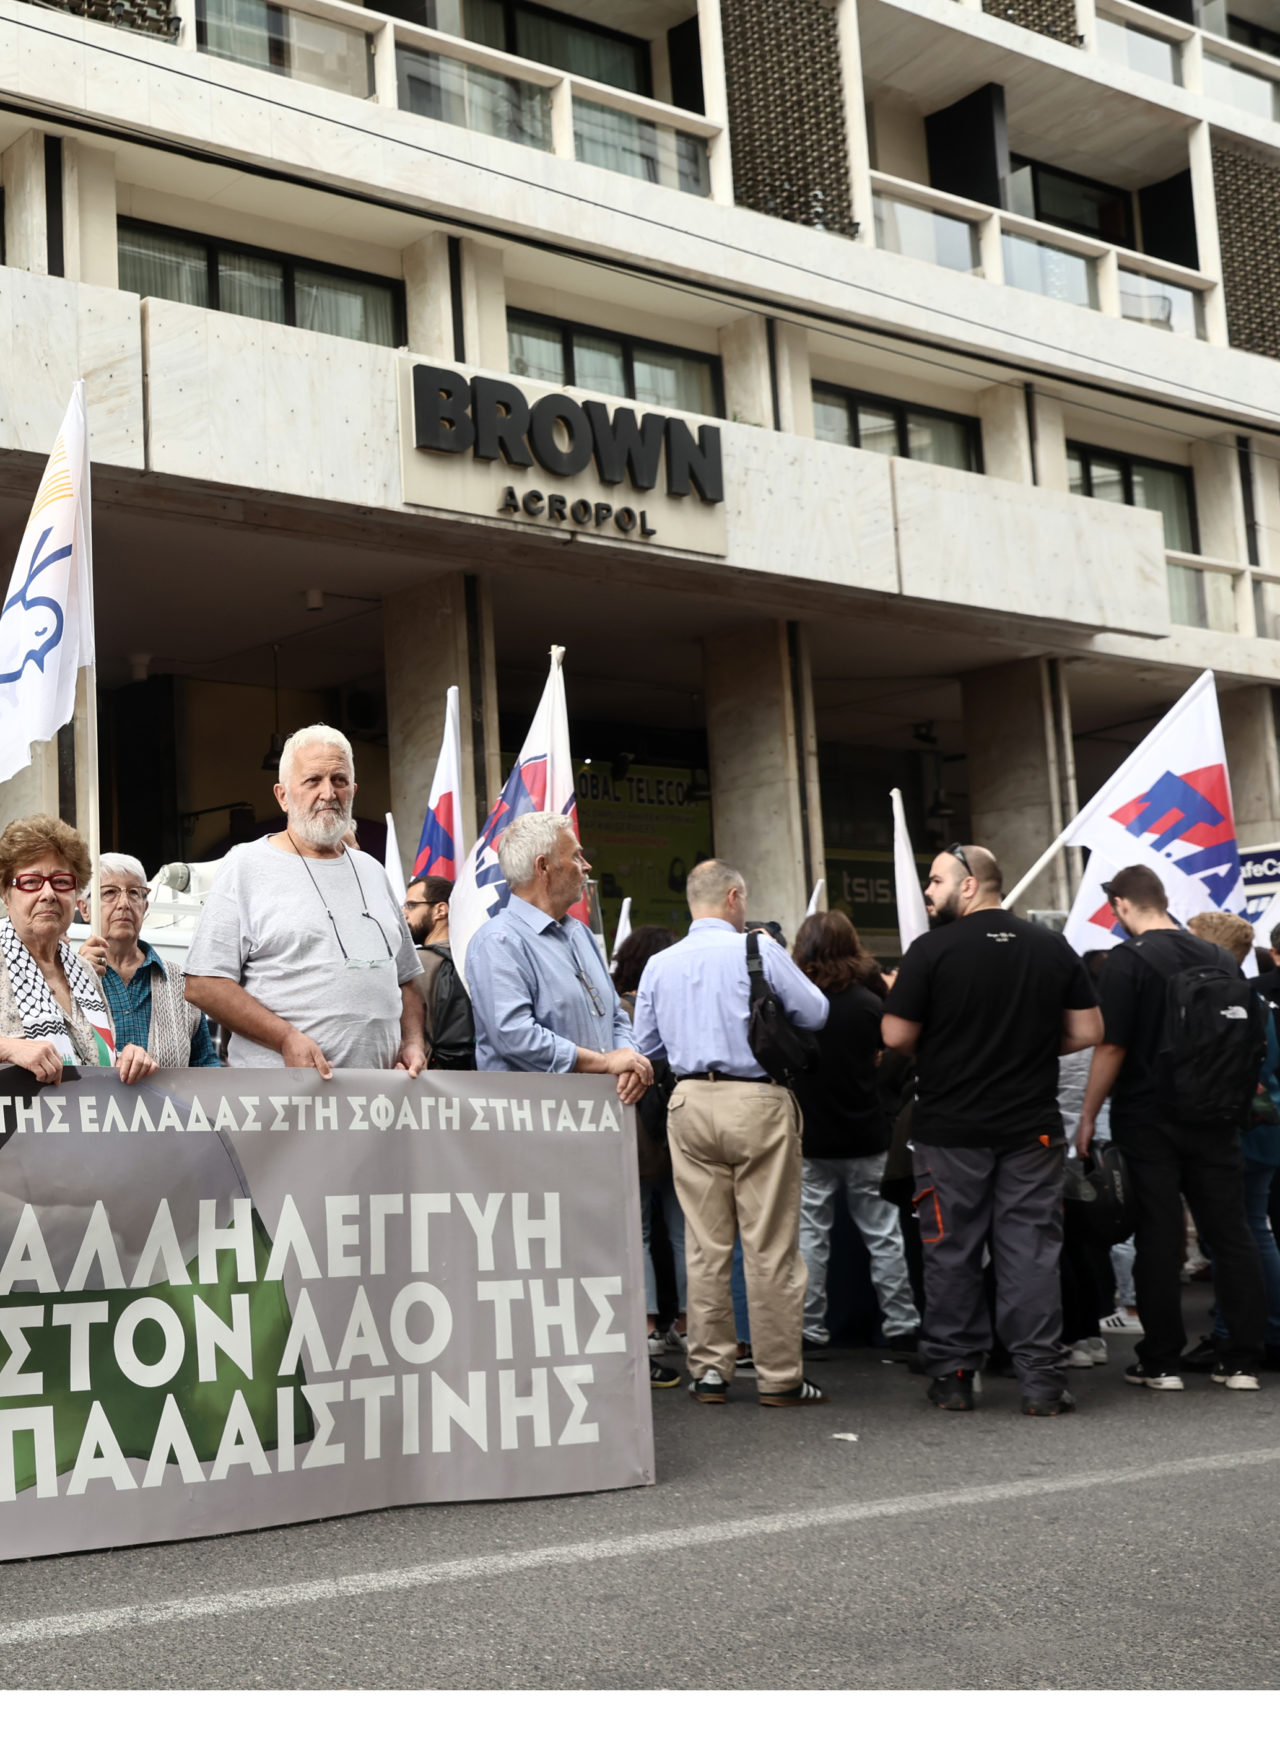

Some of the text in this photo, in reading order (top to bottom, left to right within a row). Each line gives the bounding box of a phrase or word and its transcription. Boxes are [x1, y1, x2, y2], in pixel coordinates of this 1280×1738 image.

[412, 363, 724, 505] BROWN
[497, 485, 656, 537] ACROPOL
[79, 1094, 262, 1133] ΕΛΛΑΔΑΣ
[268, 1096, 339, 1131] ΣΤΗ
[347, 1094, 460, 1131] ΣΦΑΓΗ
[468, 1097, 533, 1132] ΣΤΗ
[541, 1099, 621, 1132] ΓΑΖΑ
[277, 1281, 453, 1376] ΛΑΟ
[476, 1276, 627, 1360] ΤΗΣ
